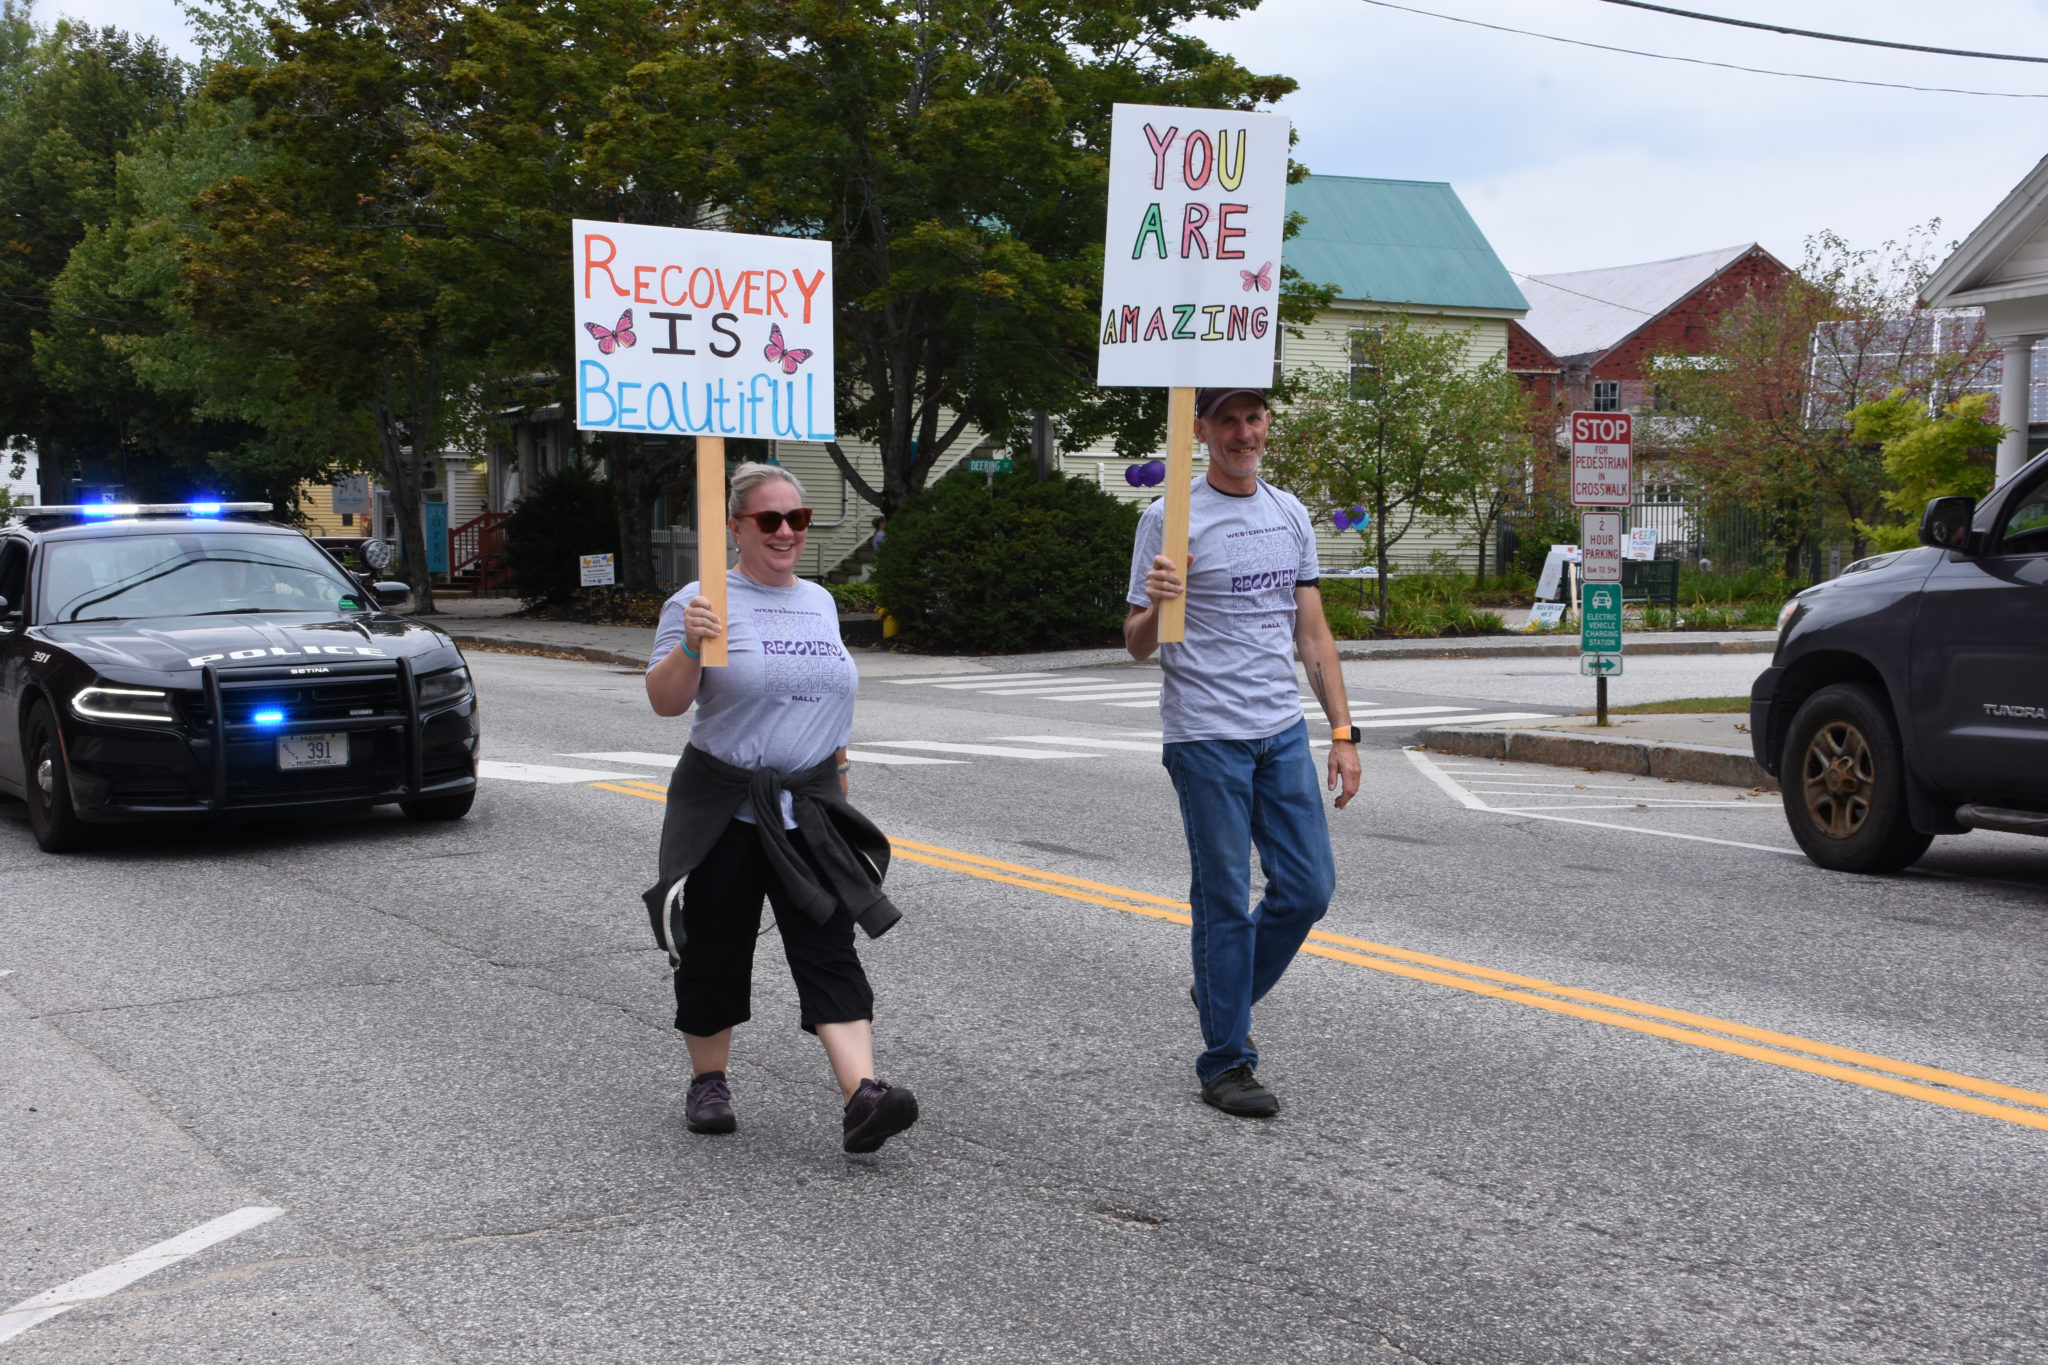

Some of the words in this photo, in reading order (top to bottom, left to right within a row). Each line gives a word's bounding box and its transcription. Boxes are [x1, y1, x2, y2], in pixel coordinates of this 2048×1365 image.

[1143, 123, 1246, 192] YOU
[1132, 203, 1248, 259] ARE
[584, 234, 825, 324] RECOVERY
[1103, 304, 1268, 344] AMAZING
[649, 312, 741, 358] IS
[1575, 418, 1628, 441] STOP
[1595, 445, 1608, 455] FOR
[970, 460, 1000, 471] DEERING
[1576, 456, 1627, 469] PEDESTRIAN
[1599, 472, 1605, 480] IN
[1576, 482, 1628, 496] CROSSWALK
[1226, 529, 1265, 539] WESTERN
[1265, 525, 1289, 533] MAINE
[1599, 520, 1605, 531] 2
[432, 518, 442, 563] OPEN
[1590, 535, 1614, 545] HOUR
[1632, 530, 1656, 540] KEEP
[1585, 549, 1618, 560] PARKING
[31, 650, 51, 664] 391
[187, 646, 387, 667] POLICE
[762, 640, 846, 661] RECOVERY
[290, 667, 330, 675] SETINA
[791, 695, 822, 703] RALLY
[1983, 703, 2048, 719] TUNDRA
[307, 741, 332, 759] 391
[296, 759, 332, 767] MUNICIPAL
